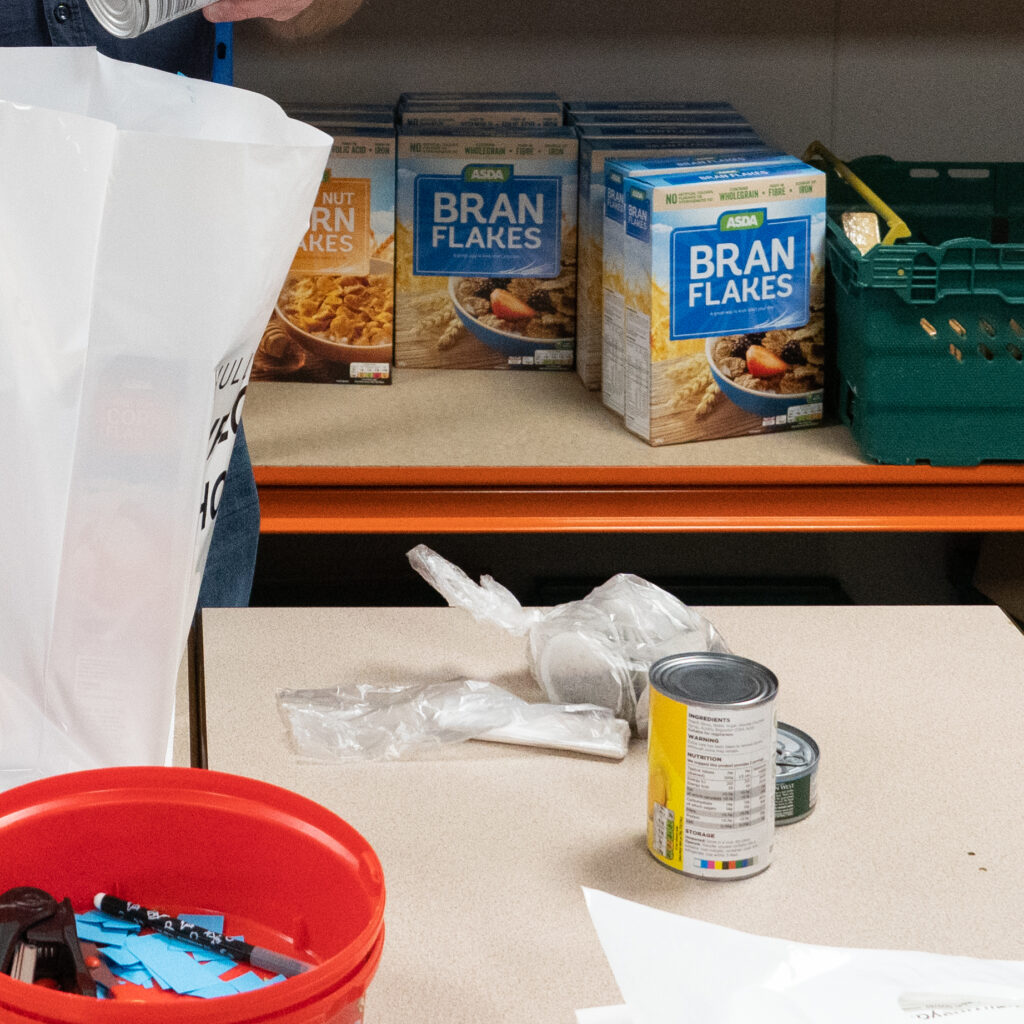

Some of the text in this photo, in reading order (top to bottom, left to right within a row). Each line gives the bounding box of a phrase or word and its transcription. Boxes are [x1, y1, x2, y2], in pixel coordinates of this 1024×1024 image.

[352, 146, 366, 154] ACID
[410, 143, 421, 152] NO
[465, 147, 505, 155] WHOLEGRAIN
[471, 170, 504, 180] ASDA
[322, 192, 355, 205] NUT
[666, 185, 812, 204] NO WHOLEGRAIN FIBRE IRON
[434, 193, 544, 224] BRAN
[628, 204, 648, 221] BRAN
[627, 216, 647, 229] FLAKES
[726, 215, 758, 228] ASDA
[432, 226, 542, 249] FLAKES
[689, 236, 795, 280] BRAN
[688, 273, 793, 308] FLAKES
[689, 713, 730, 722] INGREDIENTS
[688, 734, 719, 743] WARNING
[688, 752, 722, 762] NUTRITION
[684, 828, 715, 838] STORAGE
